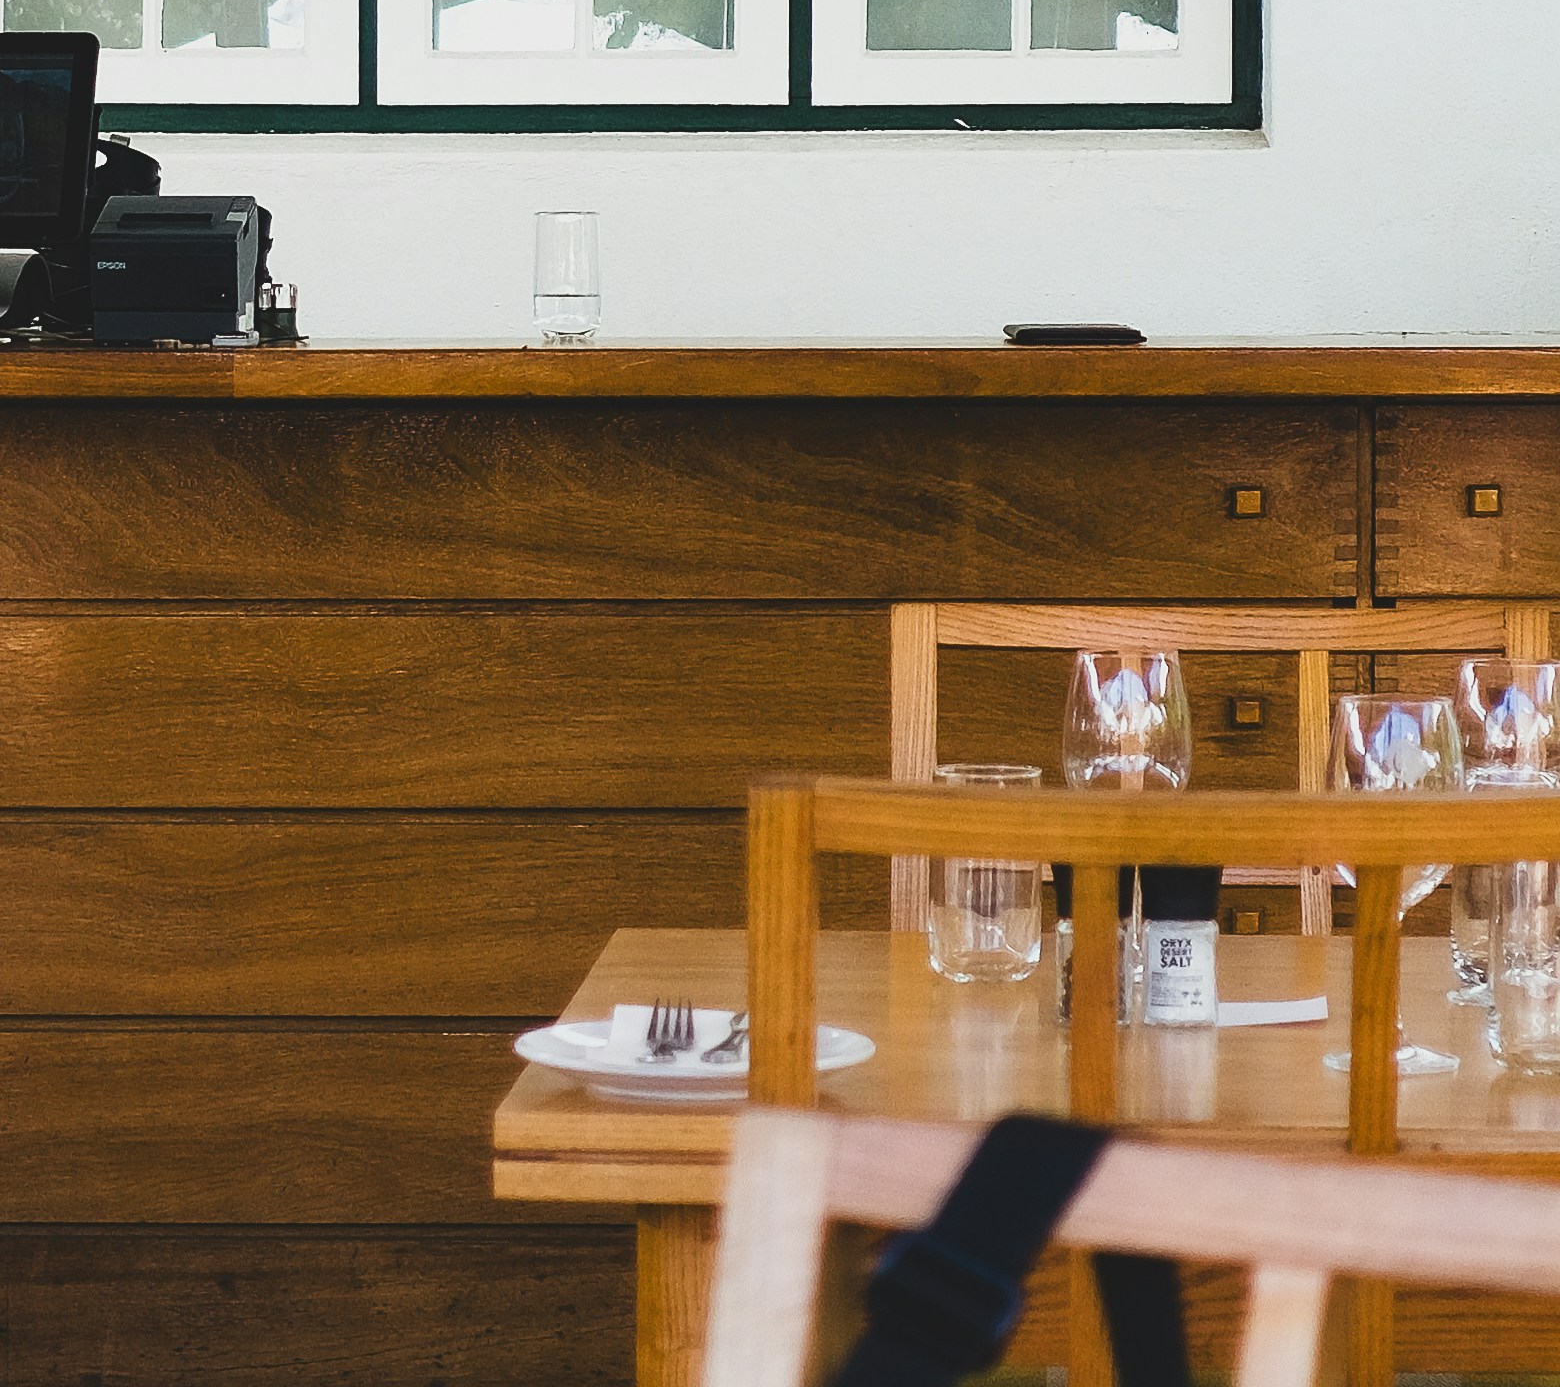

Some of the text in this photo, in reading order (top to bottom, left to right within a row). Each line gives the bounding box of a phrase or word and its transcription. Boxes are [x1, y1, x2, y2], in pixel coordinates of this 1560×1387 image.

[97, 261, 126, 270] EPSON
[1160, 938, 1193, 948] ORYX
[1160, 957, 1193, 968] SALT
